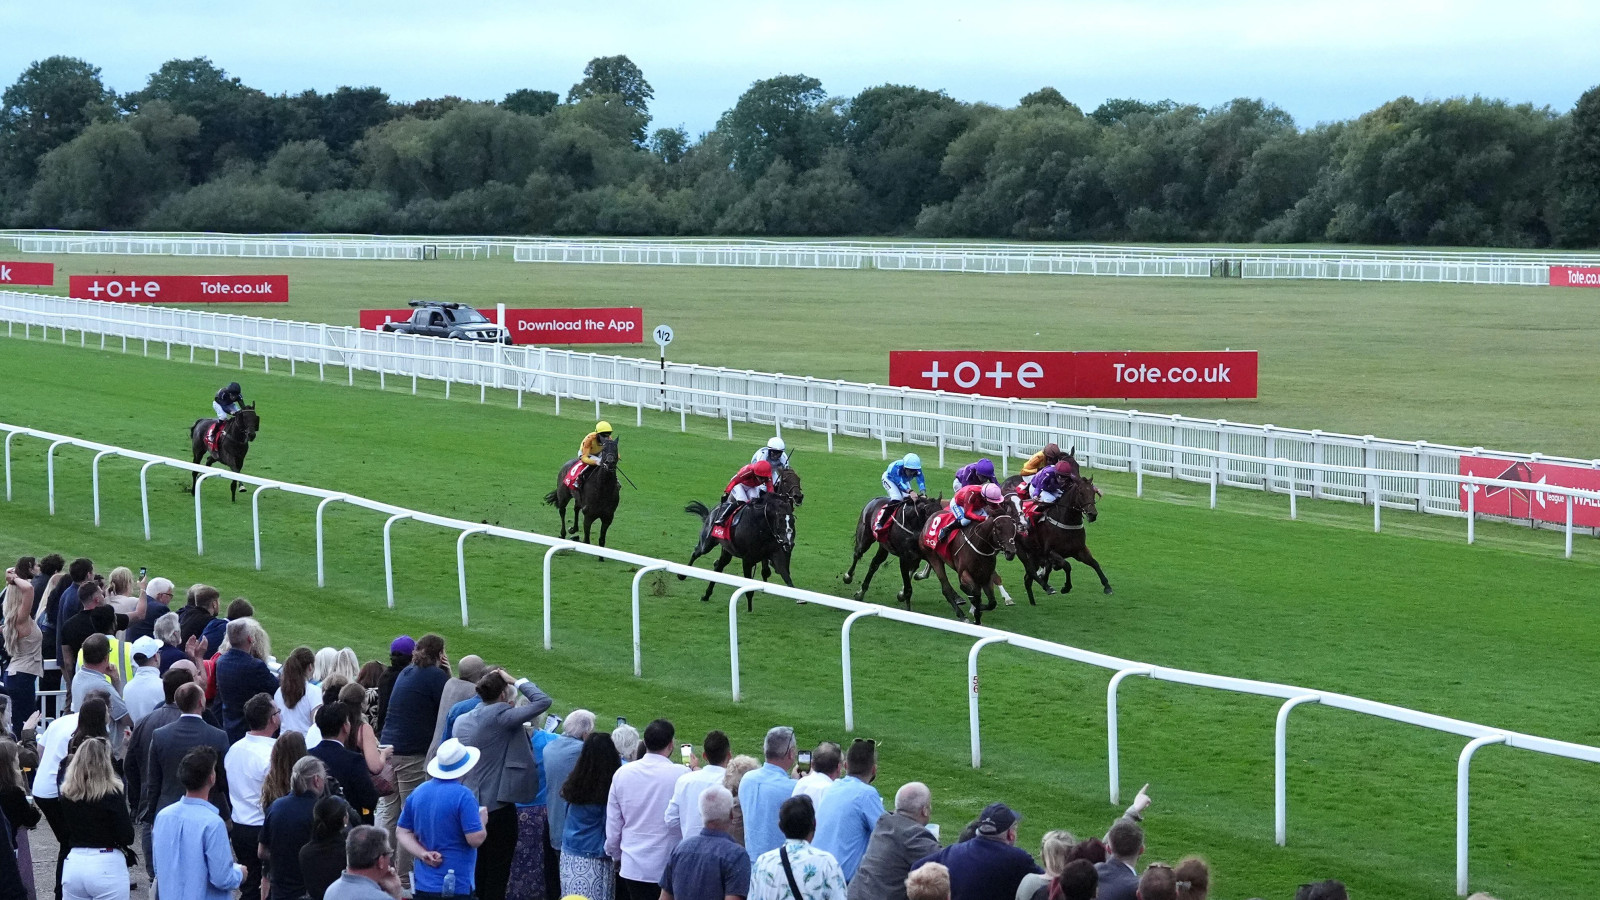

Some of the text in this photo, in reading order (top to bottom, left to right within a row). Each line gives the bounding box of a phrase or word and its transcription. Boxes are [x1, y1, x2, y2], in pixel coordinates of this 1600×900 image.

[200, 281, 273, 294] Tote.co.uk
[518, 318, 635, 332] Download the App
[656, 329, 671, 342] 1/2
[1113, 363, 1231, 383] Tote.co.uk
[928, 516, 942, 537] 9
